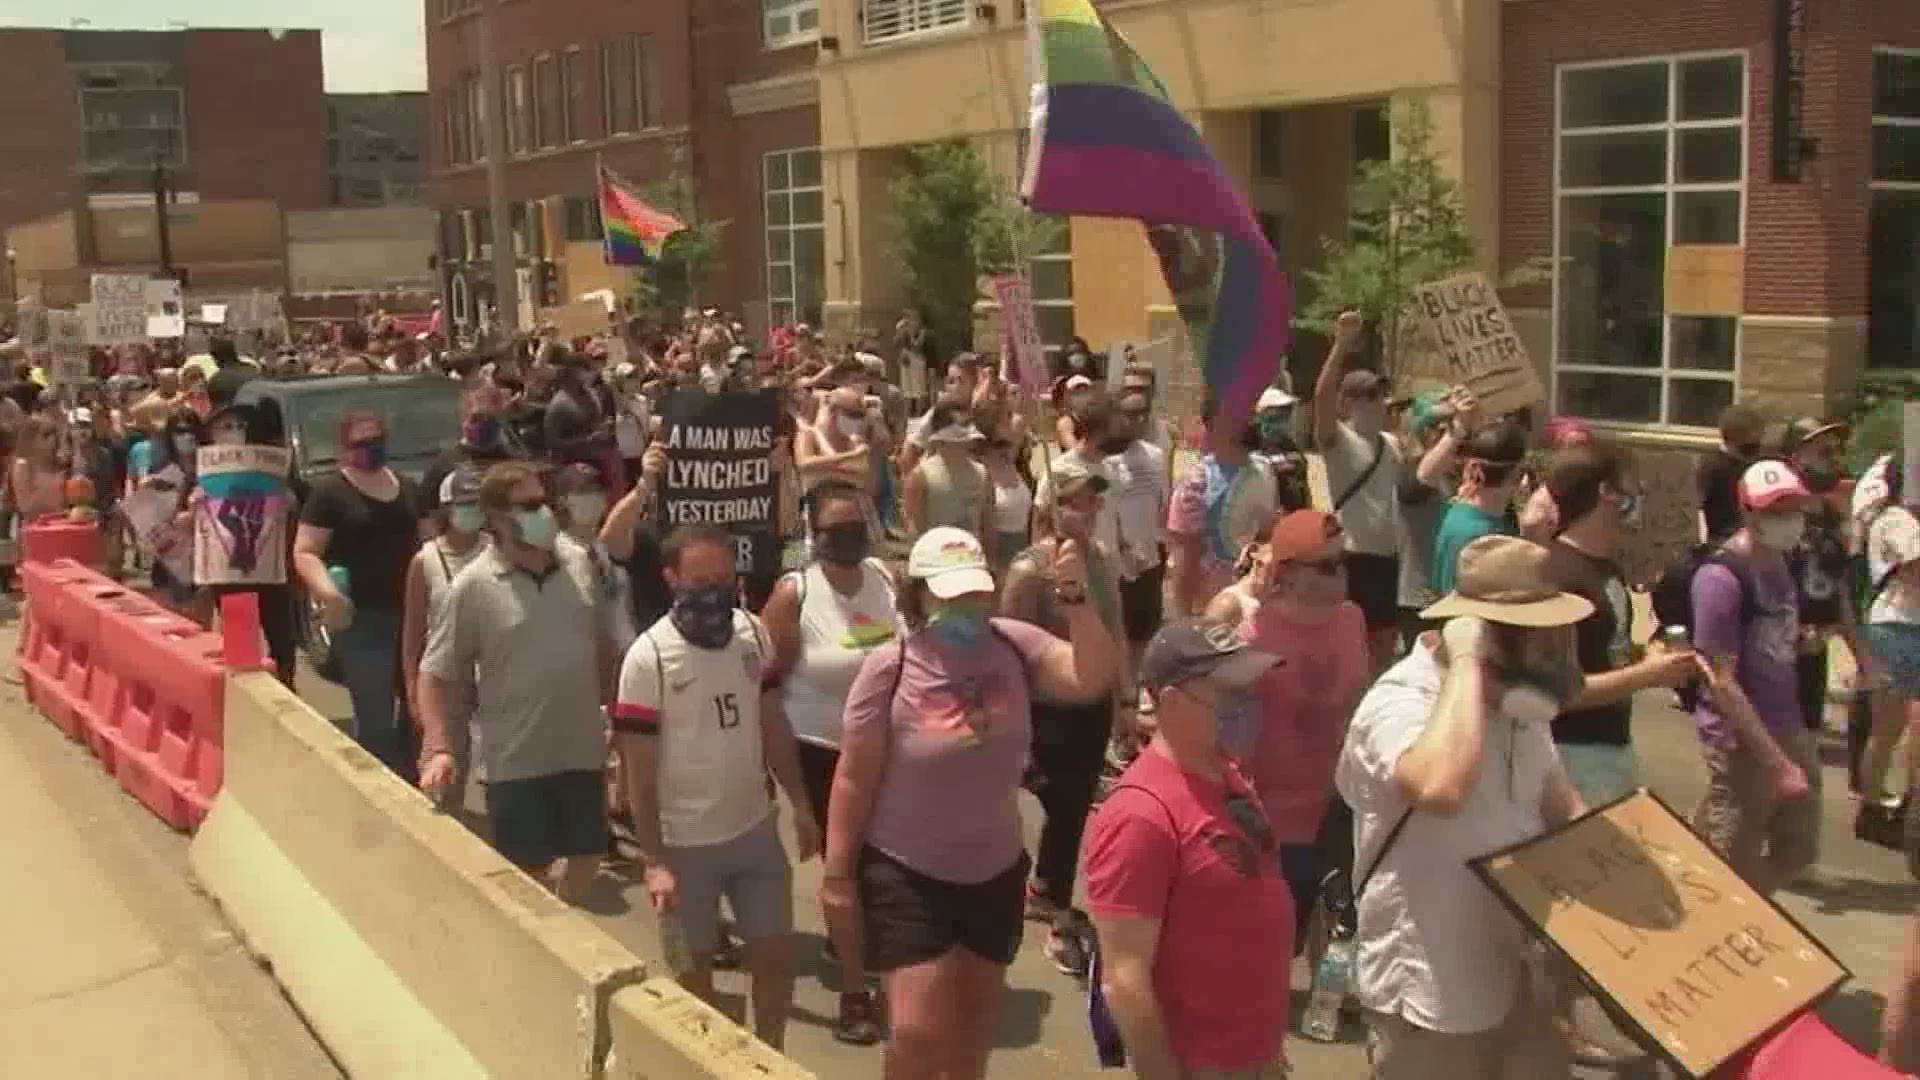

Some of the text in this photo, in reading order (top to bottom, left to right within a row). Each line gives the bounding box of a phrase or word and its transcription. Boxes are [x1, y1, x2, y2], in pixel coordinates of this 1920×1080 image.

[1437, 307, 1505, 344] LIVES
[669, 424, 772, 450] A MAN WAS
[667, 458, 770, 490] LYNCHED
[667, 497, 771, 524] YESTERDAY
[713, 692, 740, 729] 15
[1645, 923, 1785, 1027] MATTER
